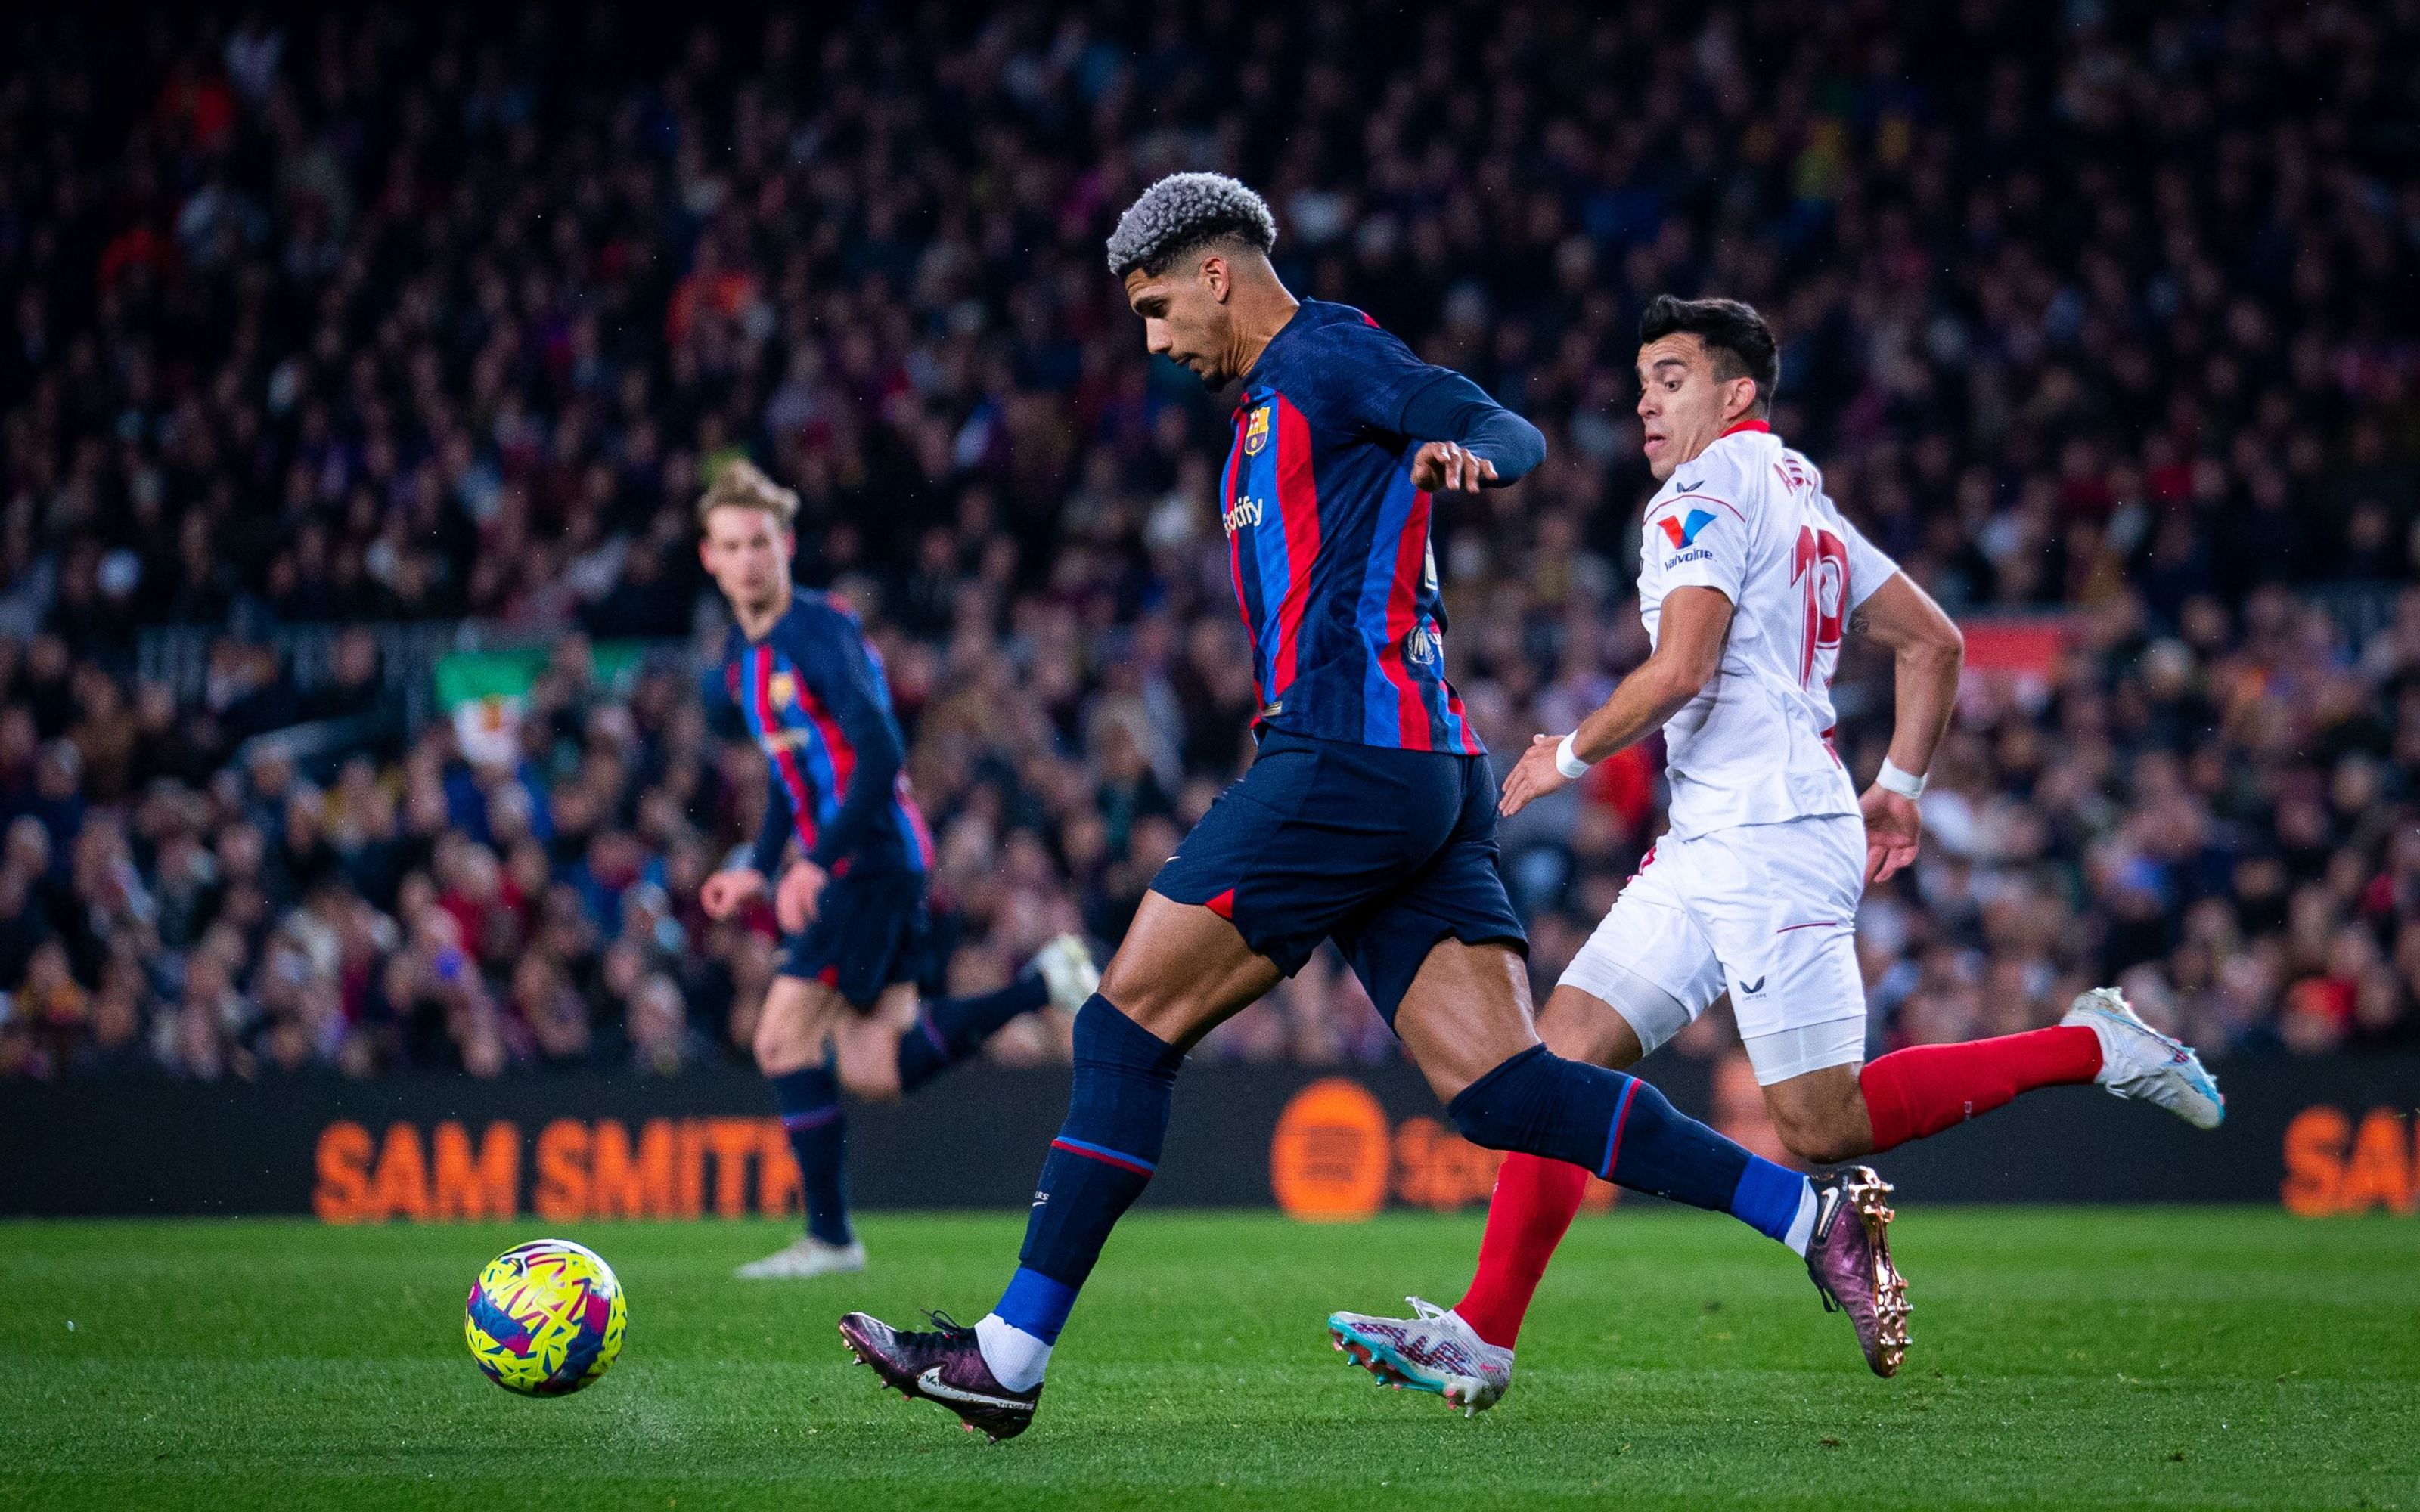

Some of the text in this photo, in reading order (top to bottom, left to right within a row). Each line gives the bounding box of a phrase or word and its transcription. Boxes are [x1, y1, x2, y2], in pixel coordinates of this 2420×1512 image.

[1222, 495, 1263, 538] potify
[315, 1120, 520, 1223] SAM
[2281, 1106, 2420, 1217] SA
